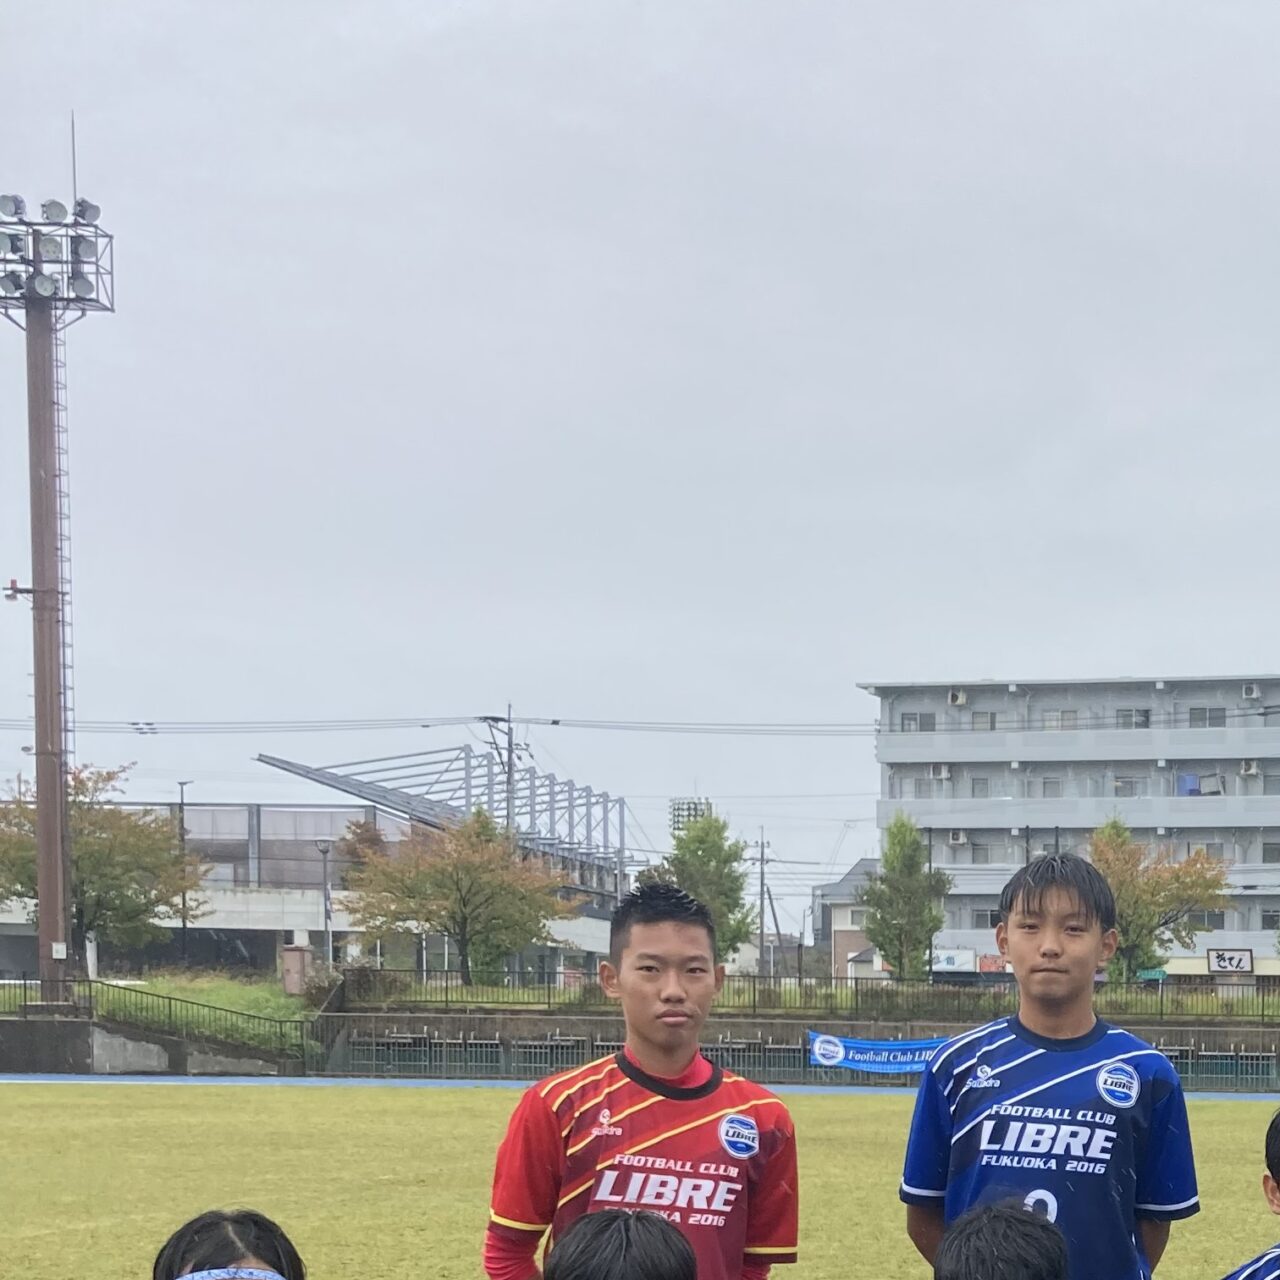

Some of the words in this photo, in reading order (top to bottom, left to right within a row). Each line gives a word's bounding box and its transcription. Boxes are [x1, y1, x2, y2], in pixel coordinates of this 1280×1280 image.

[848, 1050, 888, 1062] Football
[889, 1051, 913, 1062] Club
[1103, 1077, 1135, 1093] LIBRE
[990, 1104, 1072, 1120] FOOTBALL
[1077, 1111, 1117, 1125] CLUB
[723, 1129, 758, 1145] LIBRE
[979, 1120, 1118, 1160] LIBRE
[613, 1153, 694, 1172] FOOTBALL
[699, 1162, 739, 1178] CLUB
[981, 1154, 1057, 1170] FUKUOKA
[1065, 1160, 1107, 1174] 2016
[594, 1170, 743, 1212] LIBRE
[688, 1213, 727, 1227] 2016
